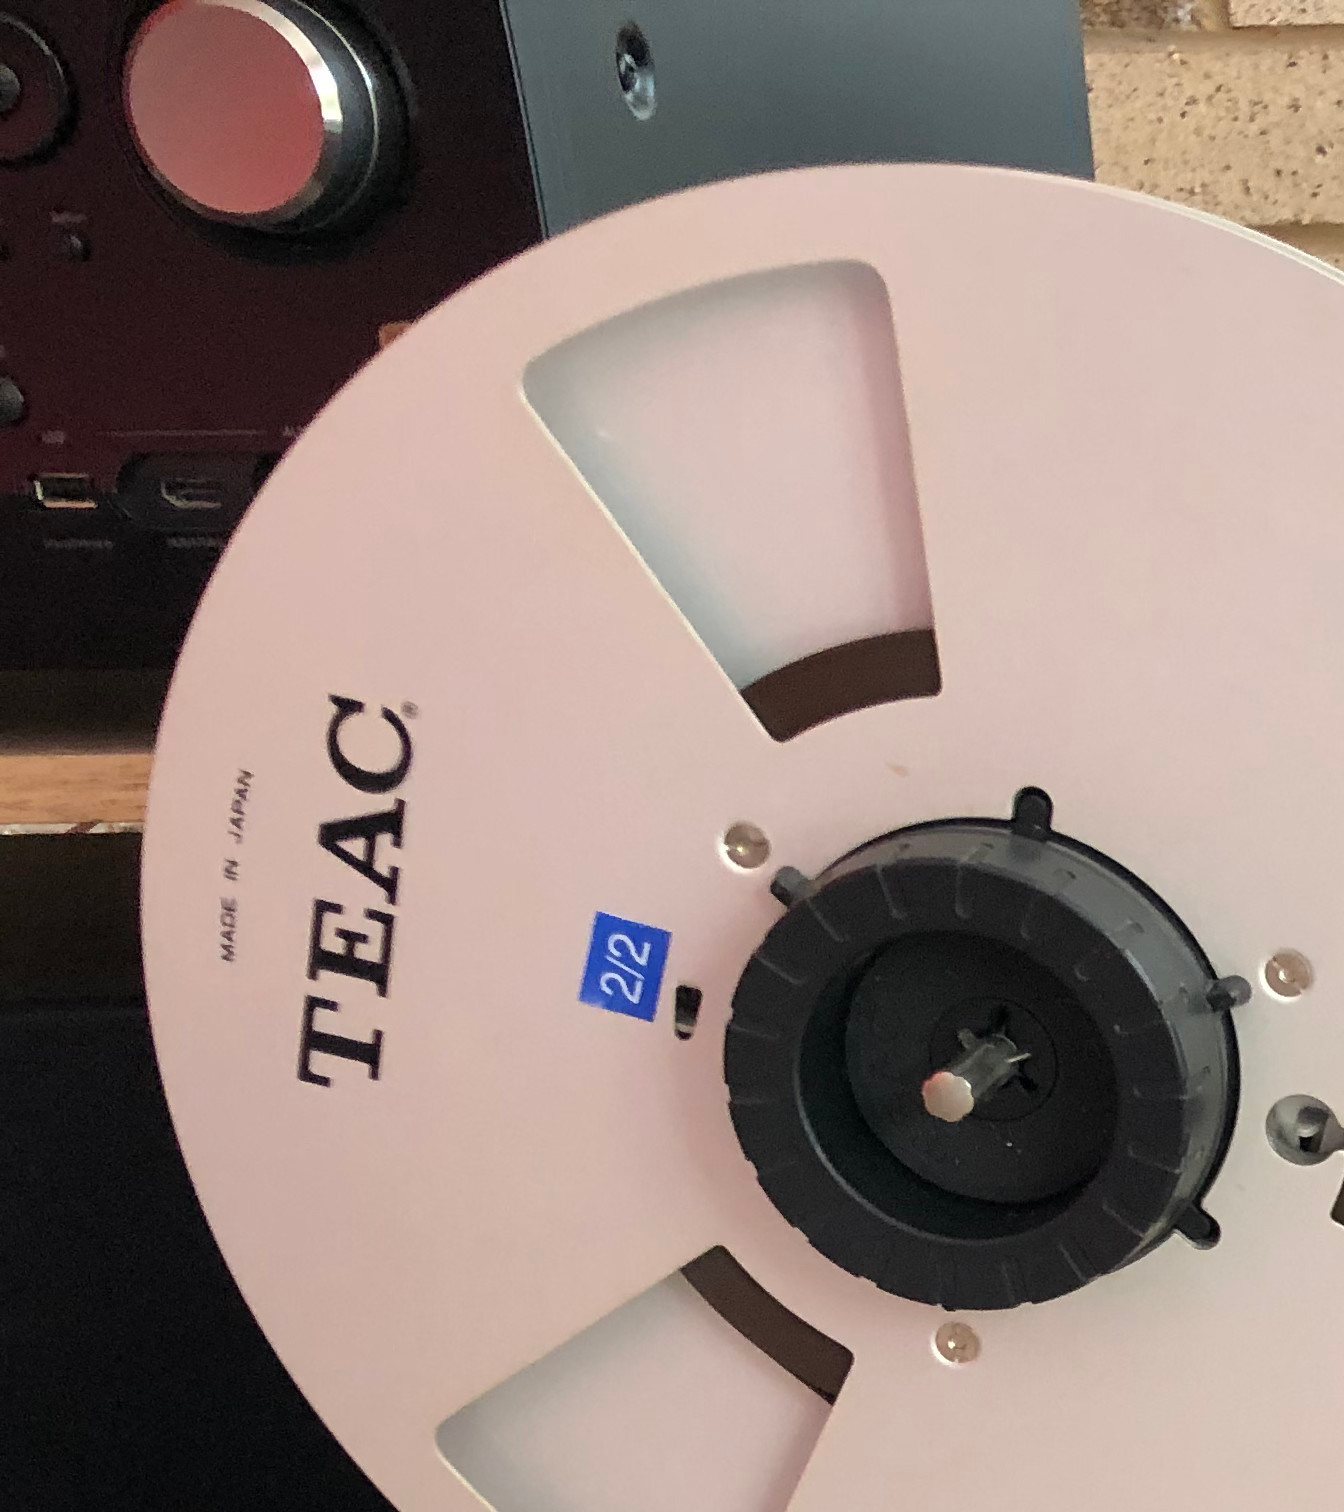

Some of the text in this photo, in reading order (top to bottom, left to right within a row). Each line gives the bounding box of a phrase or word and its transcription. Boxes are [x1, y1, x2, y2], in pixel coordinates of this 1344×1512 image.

[220, 768, 255, 963] MADE IN JAPAN
[600, 932, 652, 1005] 2/2
